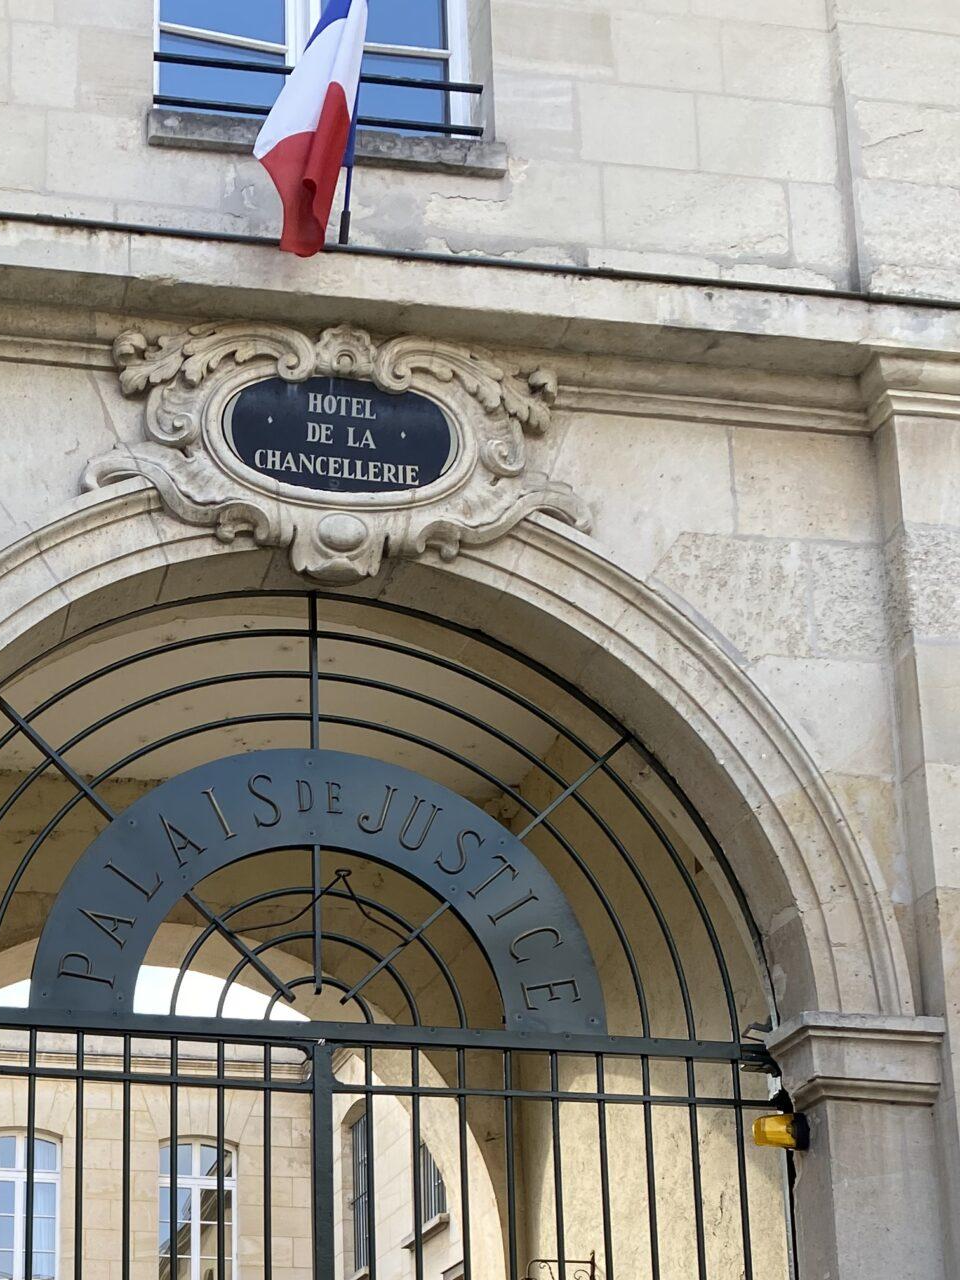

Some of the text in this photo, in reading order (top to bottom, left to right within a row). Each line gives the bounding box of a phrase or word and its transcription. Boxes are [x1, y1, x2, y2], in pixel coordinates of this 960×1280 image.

[307, 392, 377, 420] HOTEL
[306, 422, 377, 449] DE LA
[254, 449, 420, 486] CHANCELLERIE
[56, 773, 582, 1012] PALAIS DE JUSTICE
